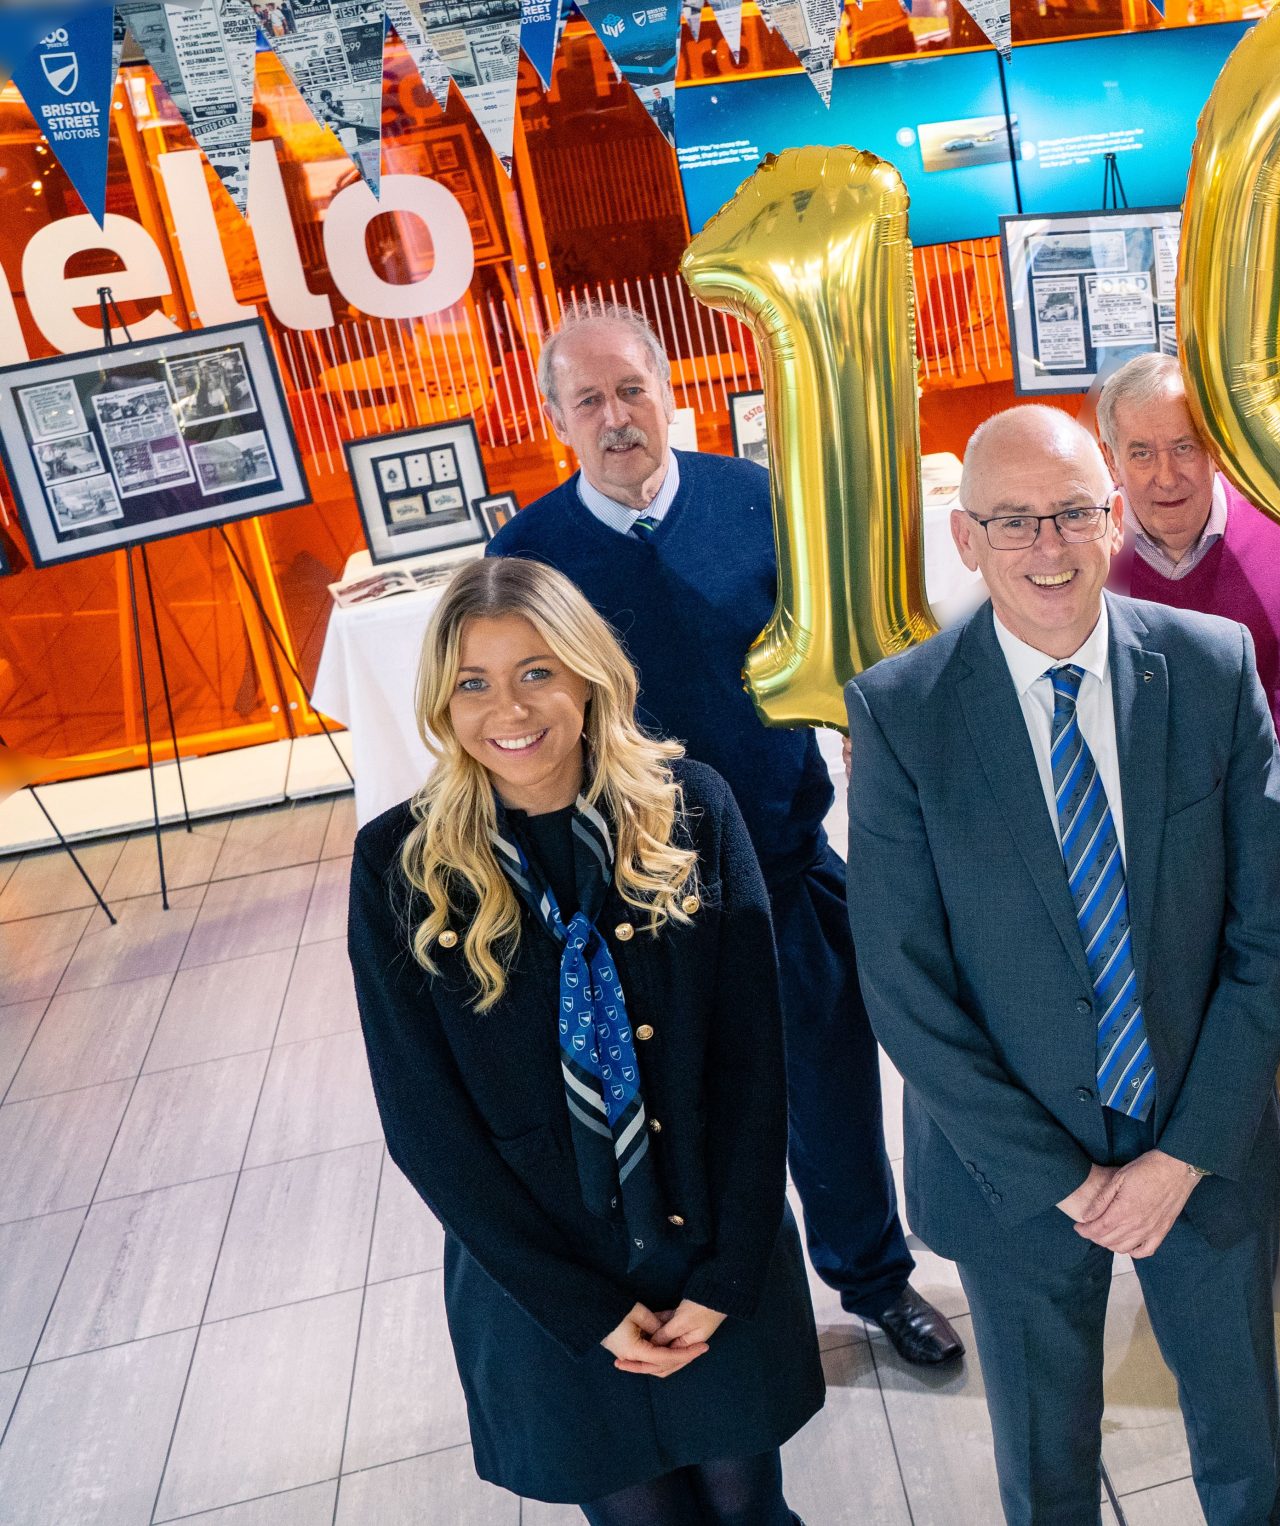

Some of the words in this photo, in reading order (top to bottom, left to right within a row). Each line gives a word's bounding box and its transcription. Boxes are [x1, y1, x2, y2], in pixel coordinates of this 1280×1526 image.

[333, 6, 365, 19] FIESTA
[646, 6, 667, 15] BRISTOL
[522, 13, 551, 25] OTORS
[601, 19, 626, 38] LIVE
[41, 101, 101, 118] BRISTOL
[47, 114, 99, 130] STREET
[53, 128, 101, 141] MOTORS
[1088, 277, 1148, 294] FORD
[743, 404, 766, 422] ASTO
